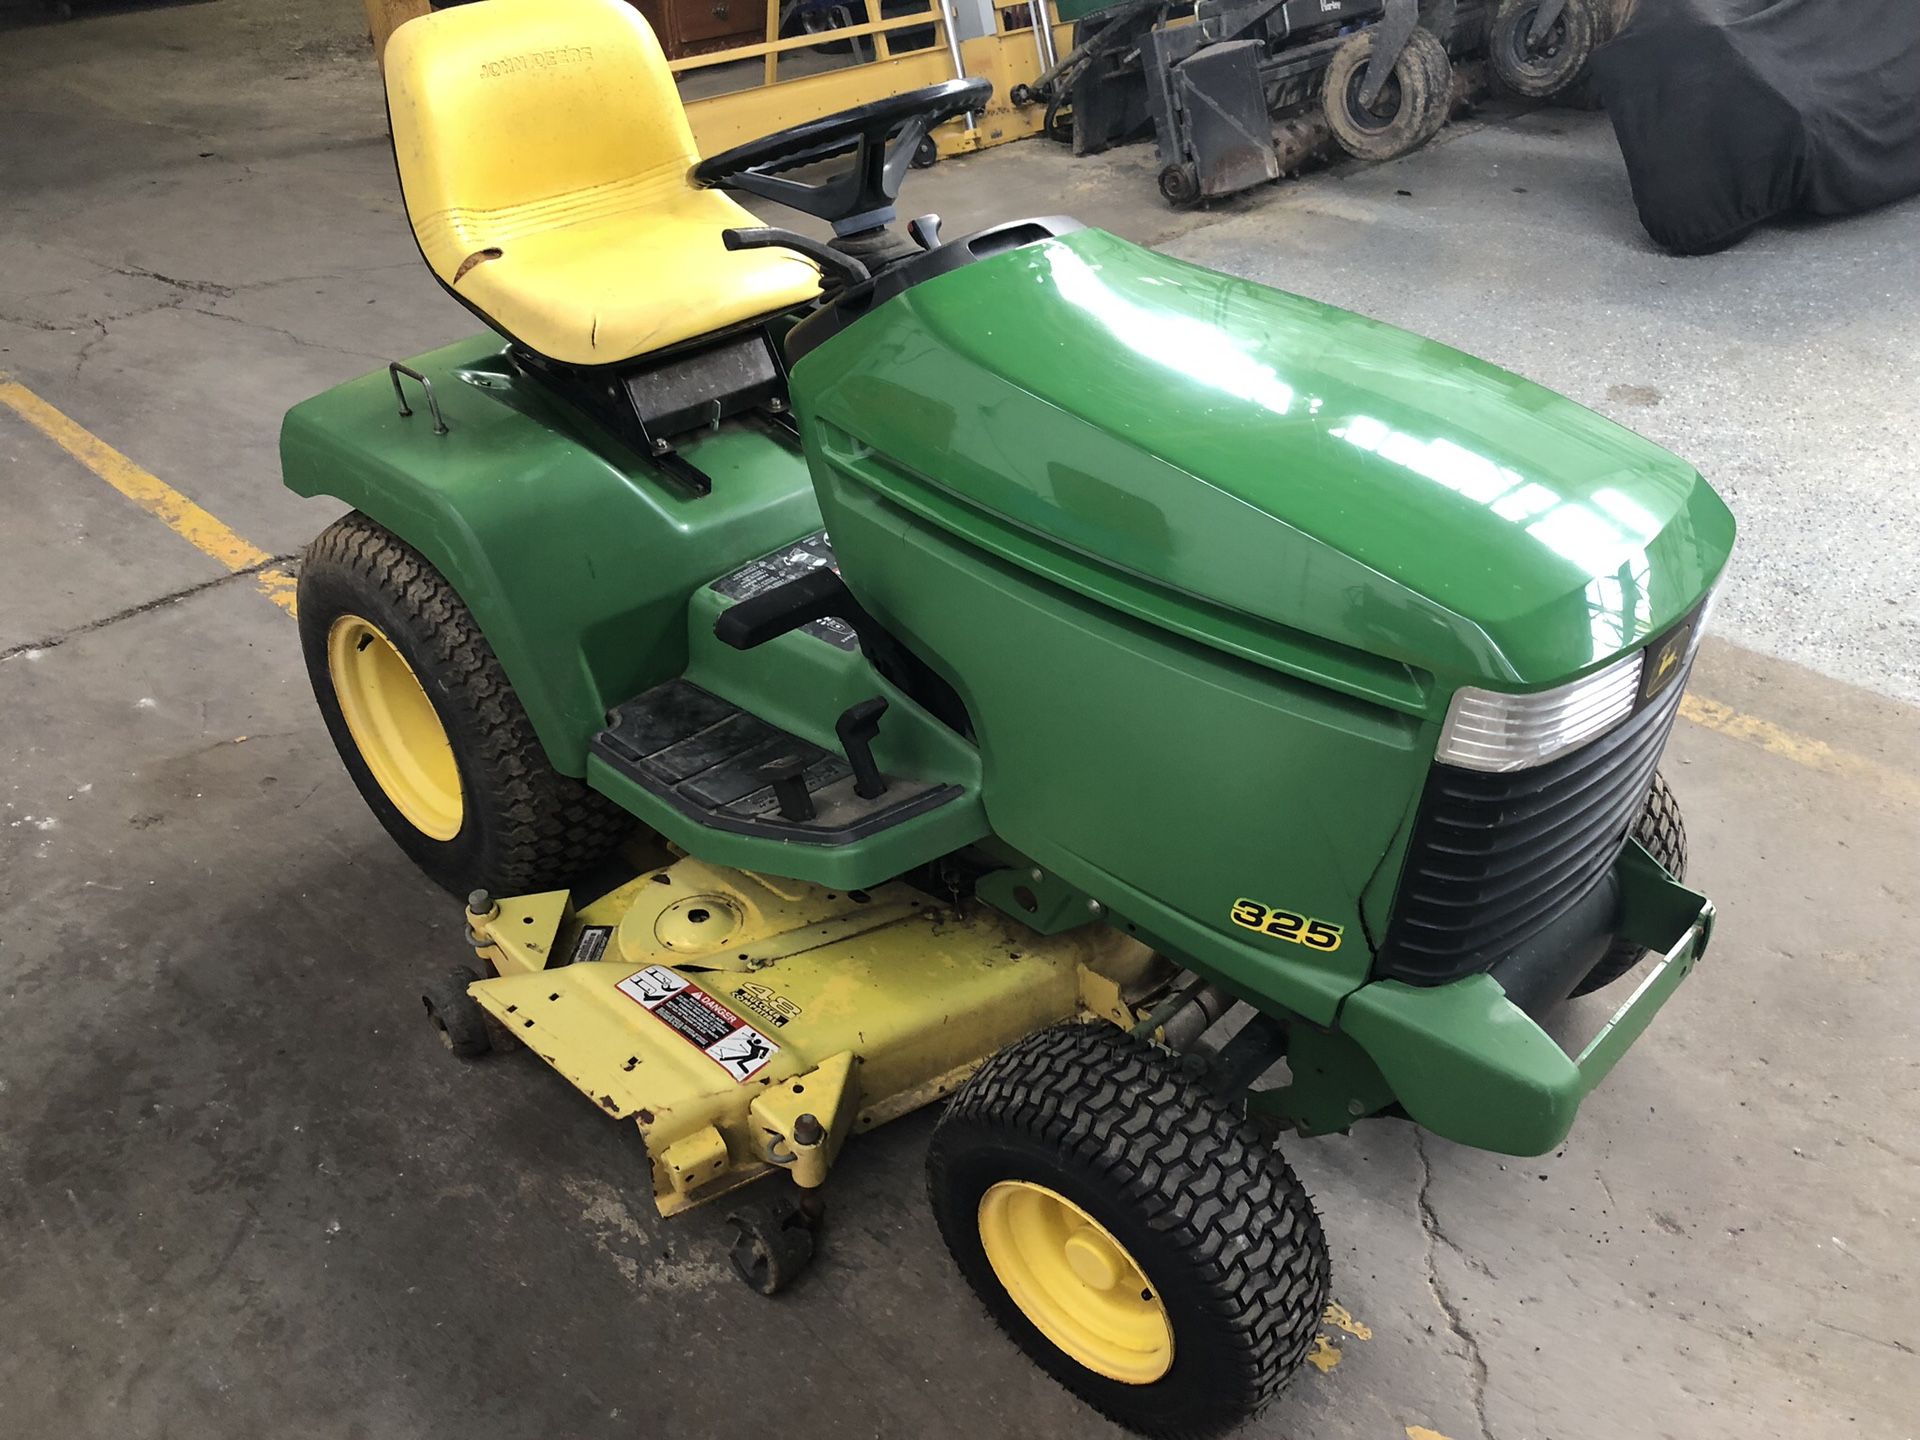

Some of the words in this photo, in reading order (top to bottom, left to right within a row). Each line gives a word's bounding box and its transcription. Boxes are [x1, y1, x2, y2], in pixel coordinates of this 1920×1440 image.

[1231, 898, 1344, 951] 325
[700, 996, 738, 1023] DANGER
[742, 981, 802, 1019] 48
